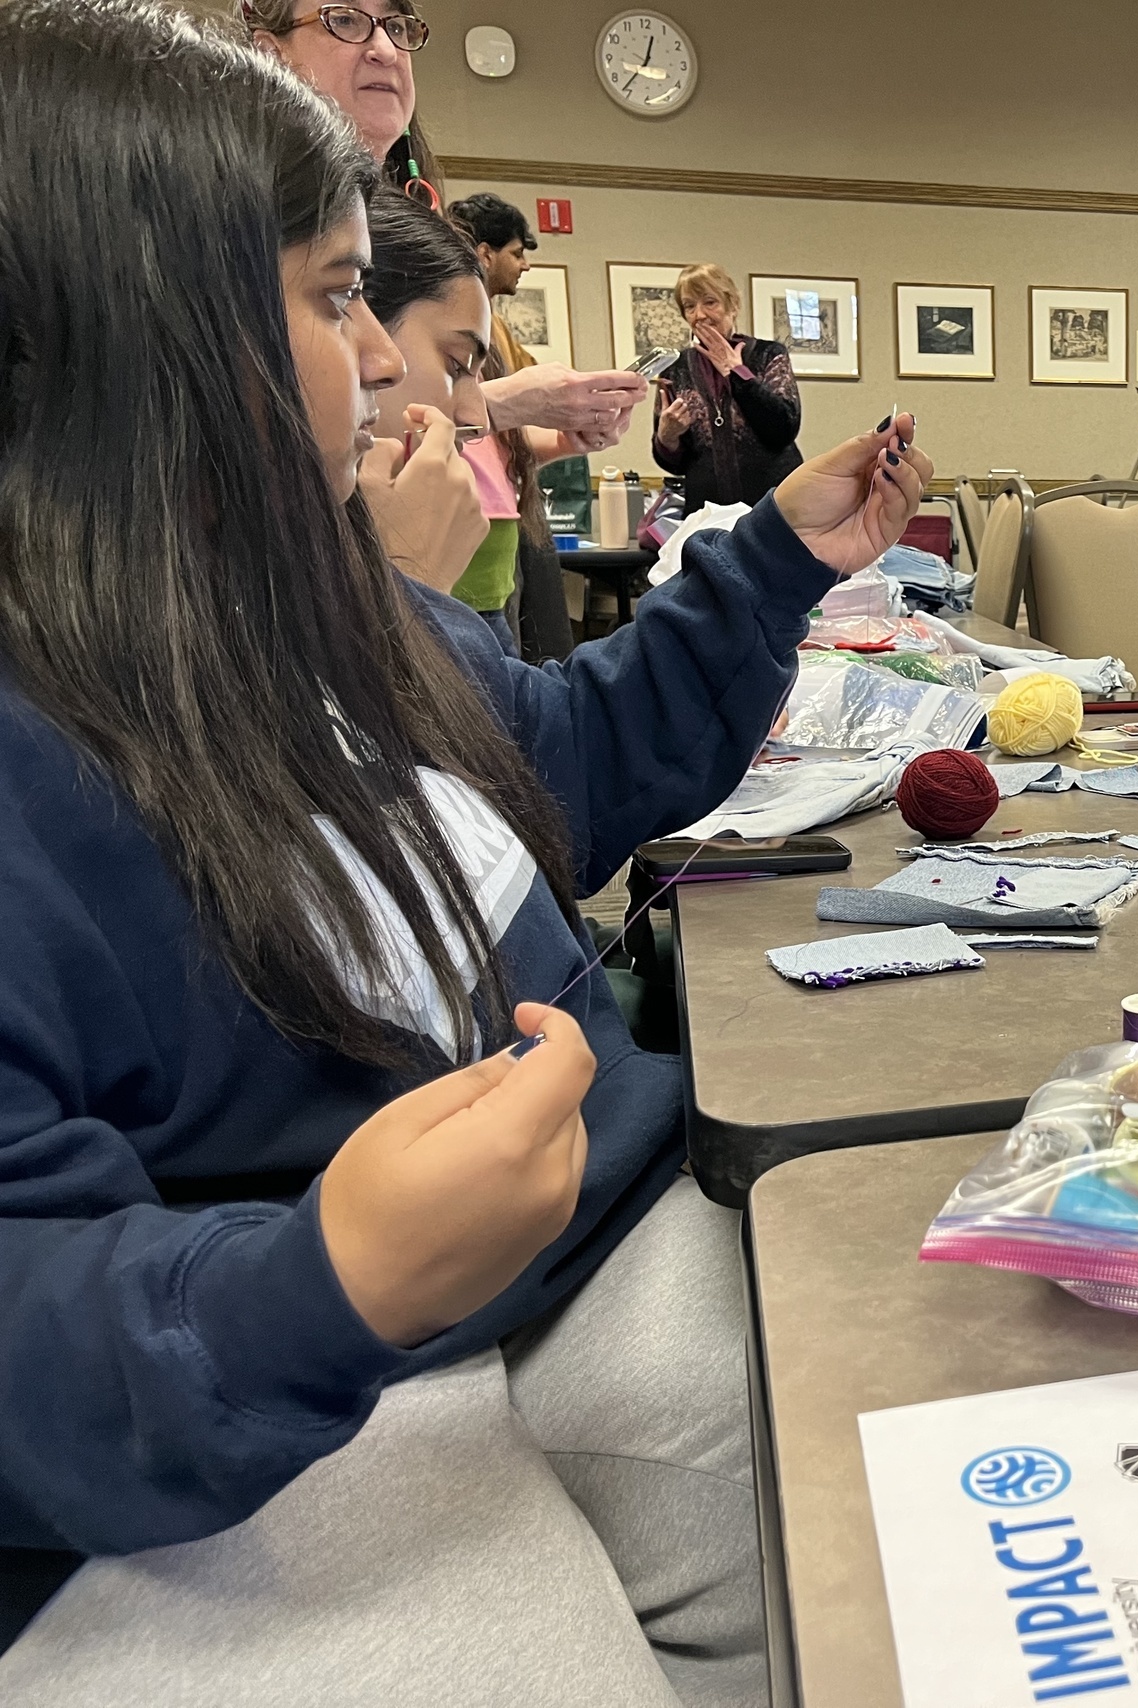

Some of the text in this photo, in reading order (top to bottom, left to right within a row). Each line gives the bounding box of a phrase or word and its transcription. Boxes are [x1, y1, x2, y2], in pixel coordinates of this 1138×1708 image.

[623, 21, 631, 32] 11
[639, 18, 651, 29] 12
[662, 25, 666, 35] 1
[608, 33, 620, 44] 10
[674, 41, 682, 51] 2
[605, 53, 613, 64] 9
[680, 61, 687, 71] 3
[611, 72, 618, 82] 8
[988, 1515, 1131, 1702] IMPACT
